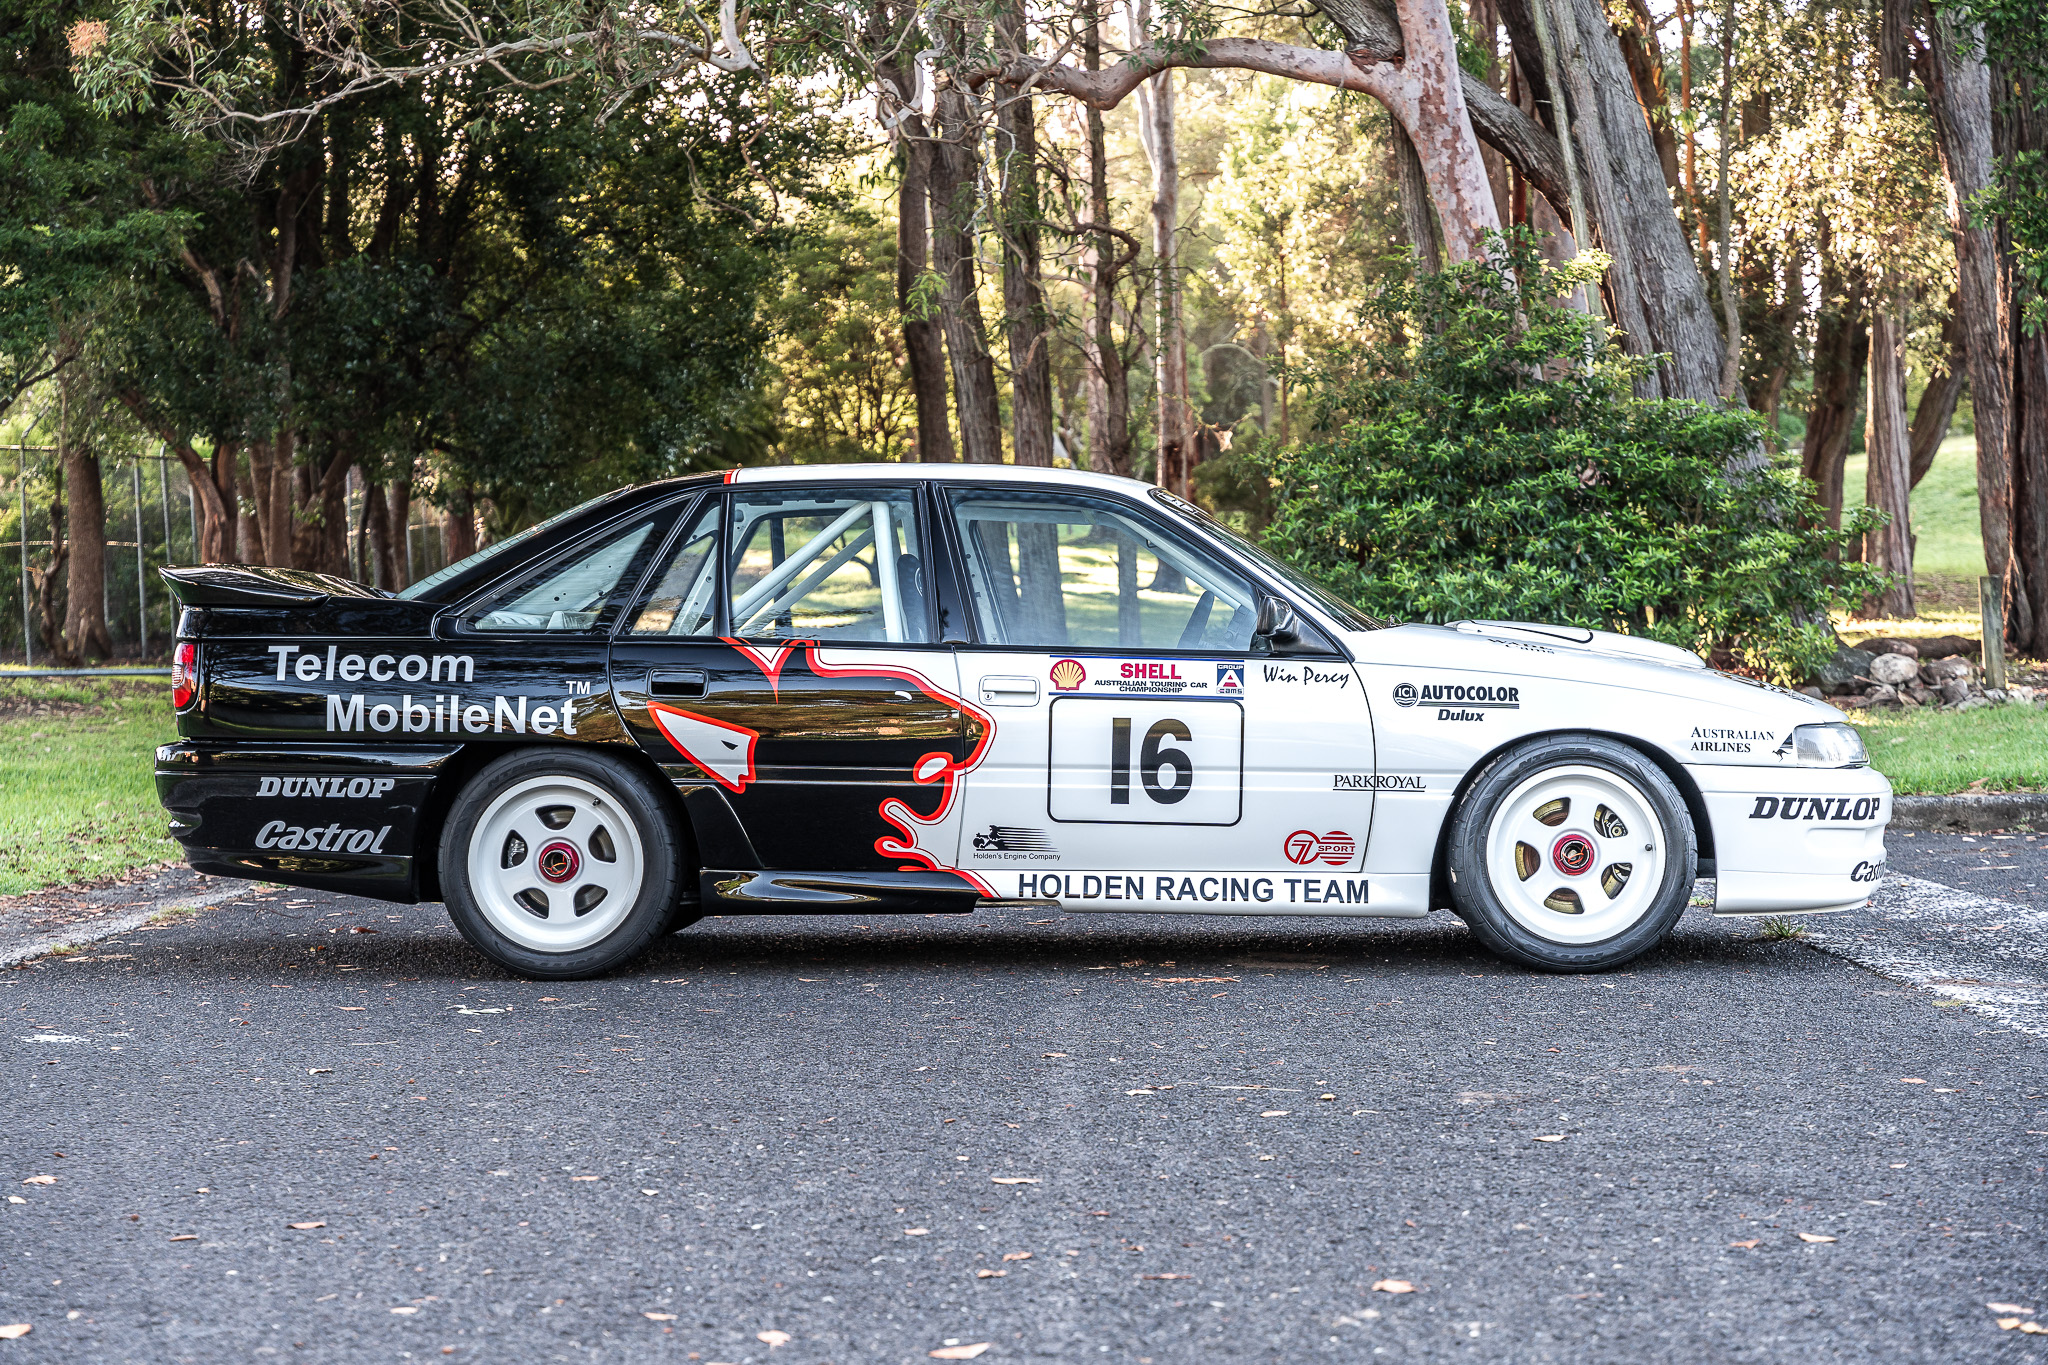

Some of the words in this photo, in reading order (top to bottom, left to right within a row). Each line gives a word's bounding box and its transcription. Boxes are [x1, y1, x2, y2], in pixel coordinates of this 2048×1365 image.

[267, 645, 475, 683] Telecom
[1120, 662, 1182, 680] SHELL
[1094, 679, 1147, 687] AUSTRALIAN
[1150, 680, 1188, 688] TOURING
[1190, 681, 1208, 689] CAR
[1263, 664, 1298, 683] Win
[1304, 665, 1349, 689] Percy
[565, 681, 591, 695] TM
[1398, 687, 1413, 697] ICI
[1420, 684, 1520, 702] AUTOCOLOR
[325, 693, 577, 735] MobileNet
[1437, 708, 1485, 722] Dulux
[1690, 726, 1774, 741] AUSTRALIAN
[1690, 742, 1751, 753] AIRLINES
[1110, 717, 1193, 805] 16
[256, 776, 395, 798] DUNLOP
[1333, 774, 1427, 790] PARKROYAL
[1748, 796, 1880, 821] DUNLOP
[254, 820, 392, 854] Castrol
[973, 852, 1002, 860] Holden's
[1003, 853, 1027, 861] Engine
[1028, 853, 1061, 861] Company
[1317, 845, 1356, 853] SPORT
[1018, 873, 1144, 901] HOLDEN
[1155, 876, 1275, 903] RACING
[1283, 878, 1369, 905] TEAM
